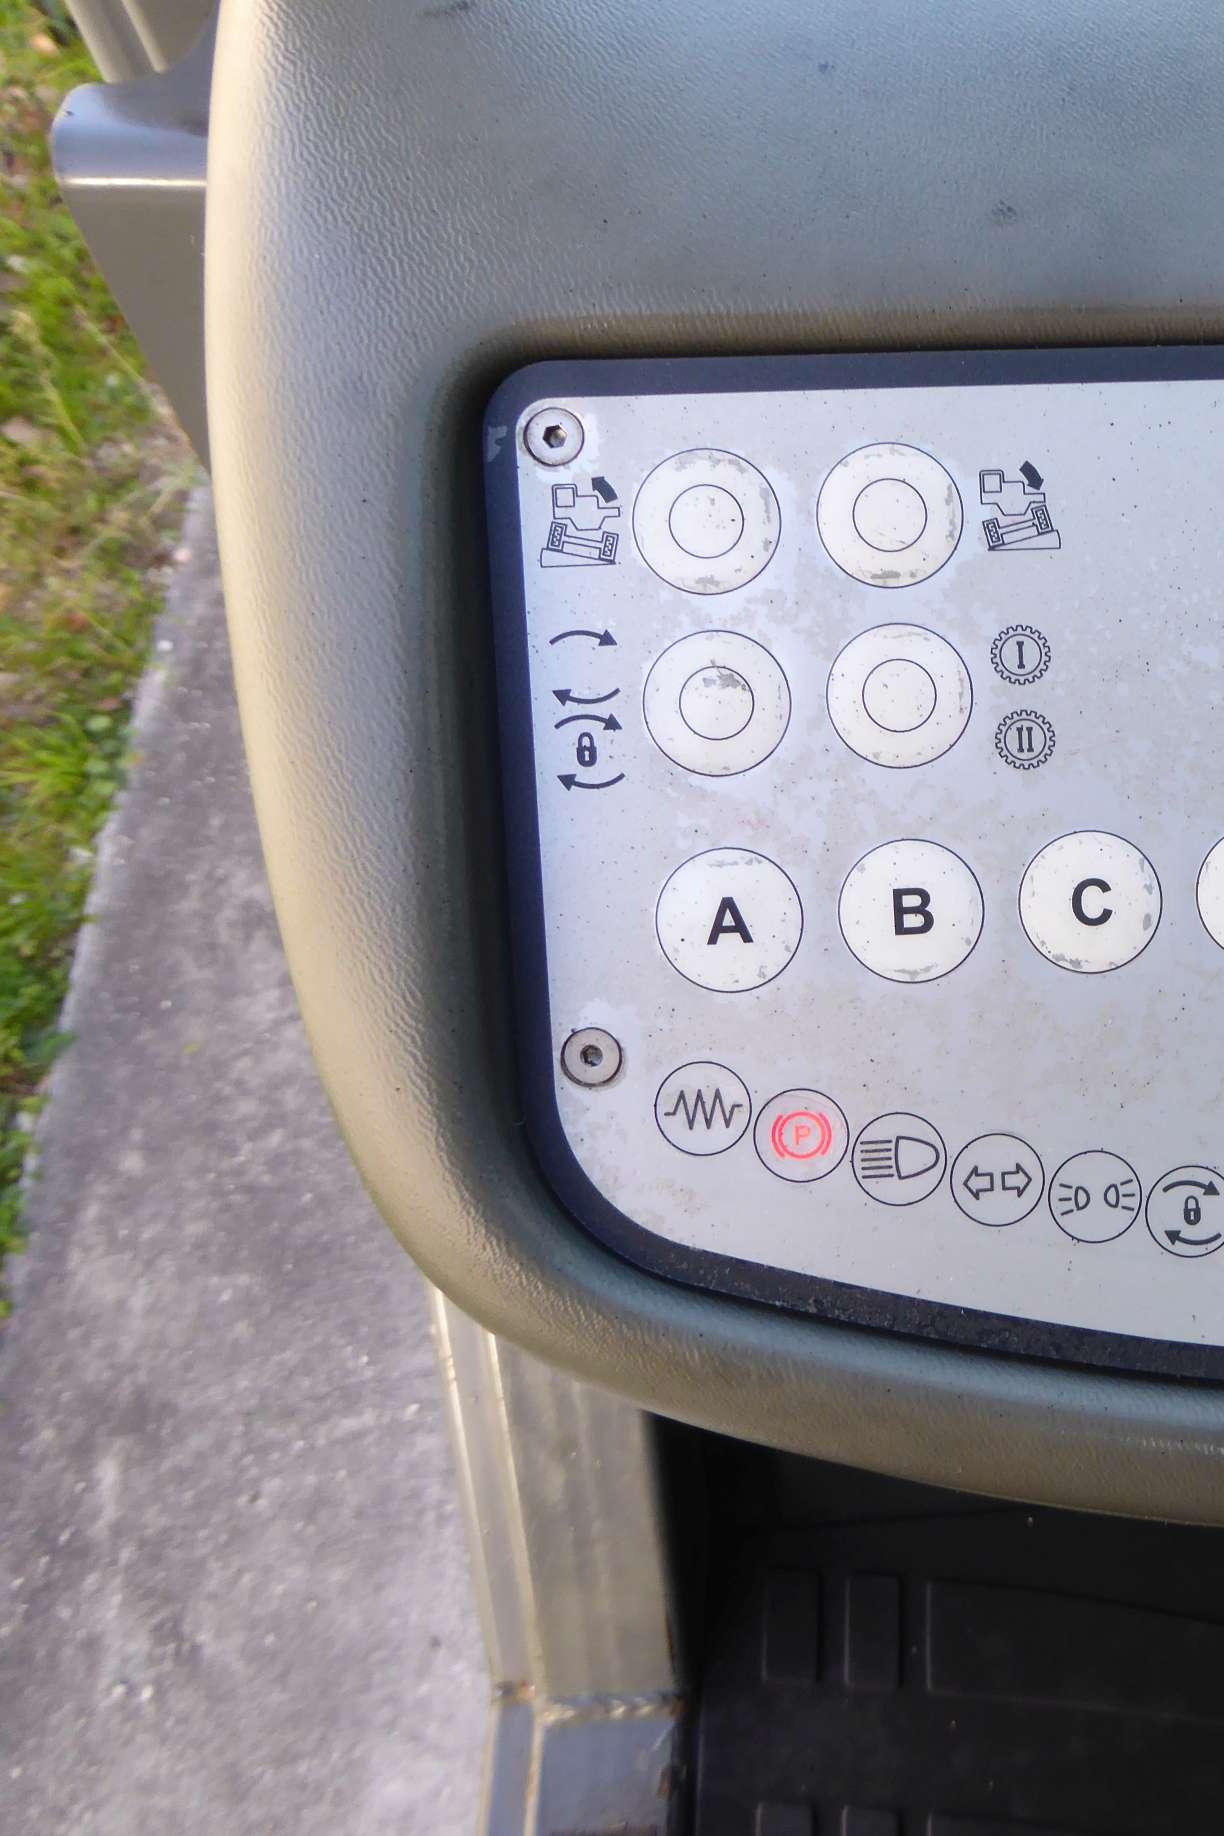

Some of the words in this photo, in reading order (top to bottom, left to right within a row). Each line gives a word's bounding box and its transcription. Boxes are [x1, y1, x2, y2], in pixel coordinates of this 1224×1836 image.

[706, 896, 754, 945] A
[892, 887, 935, 936] B
[1071, 877, 1113, 927] C
[794, 1124, 811, 1146] P
